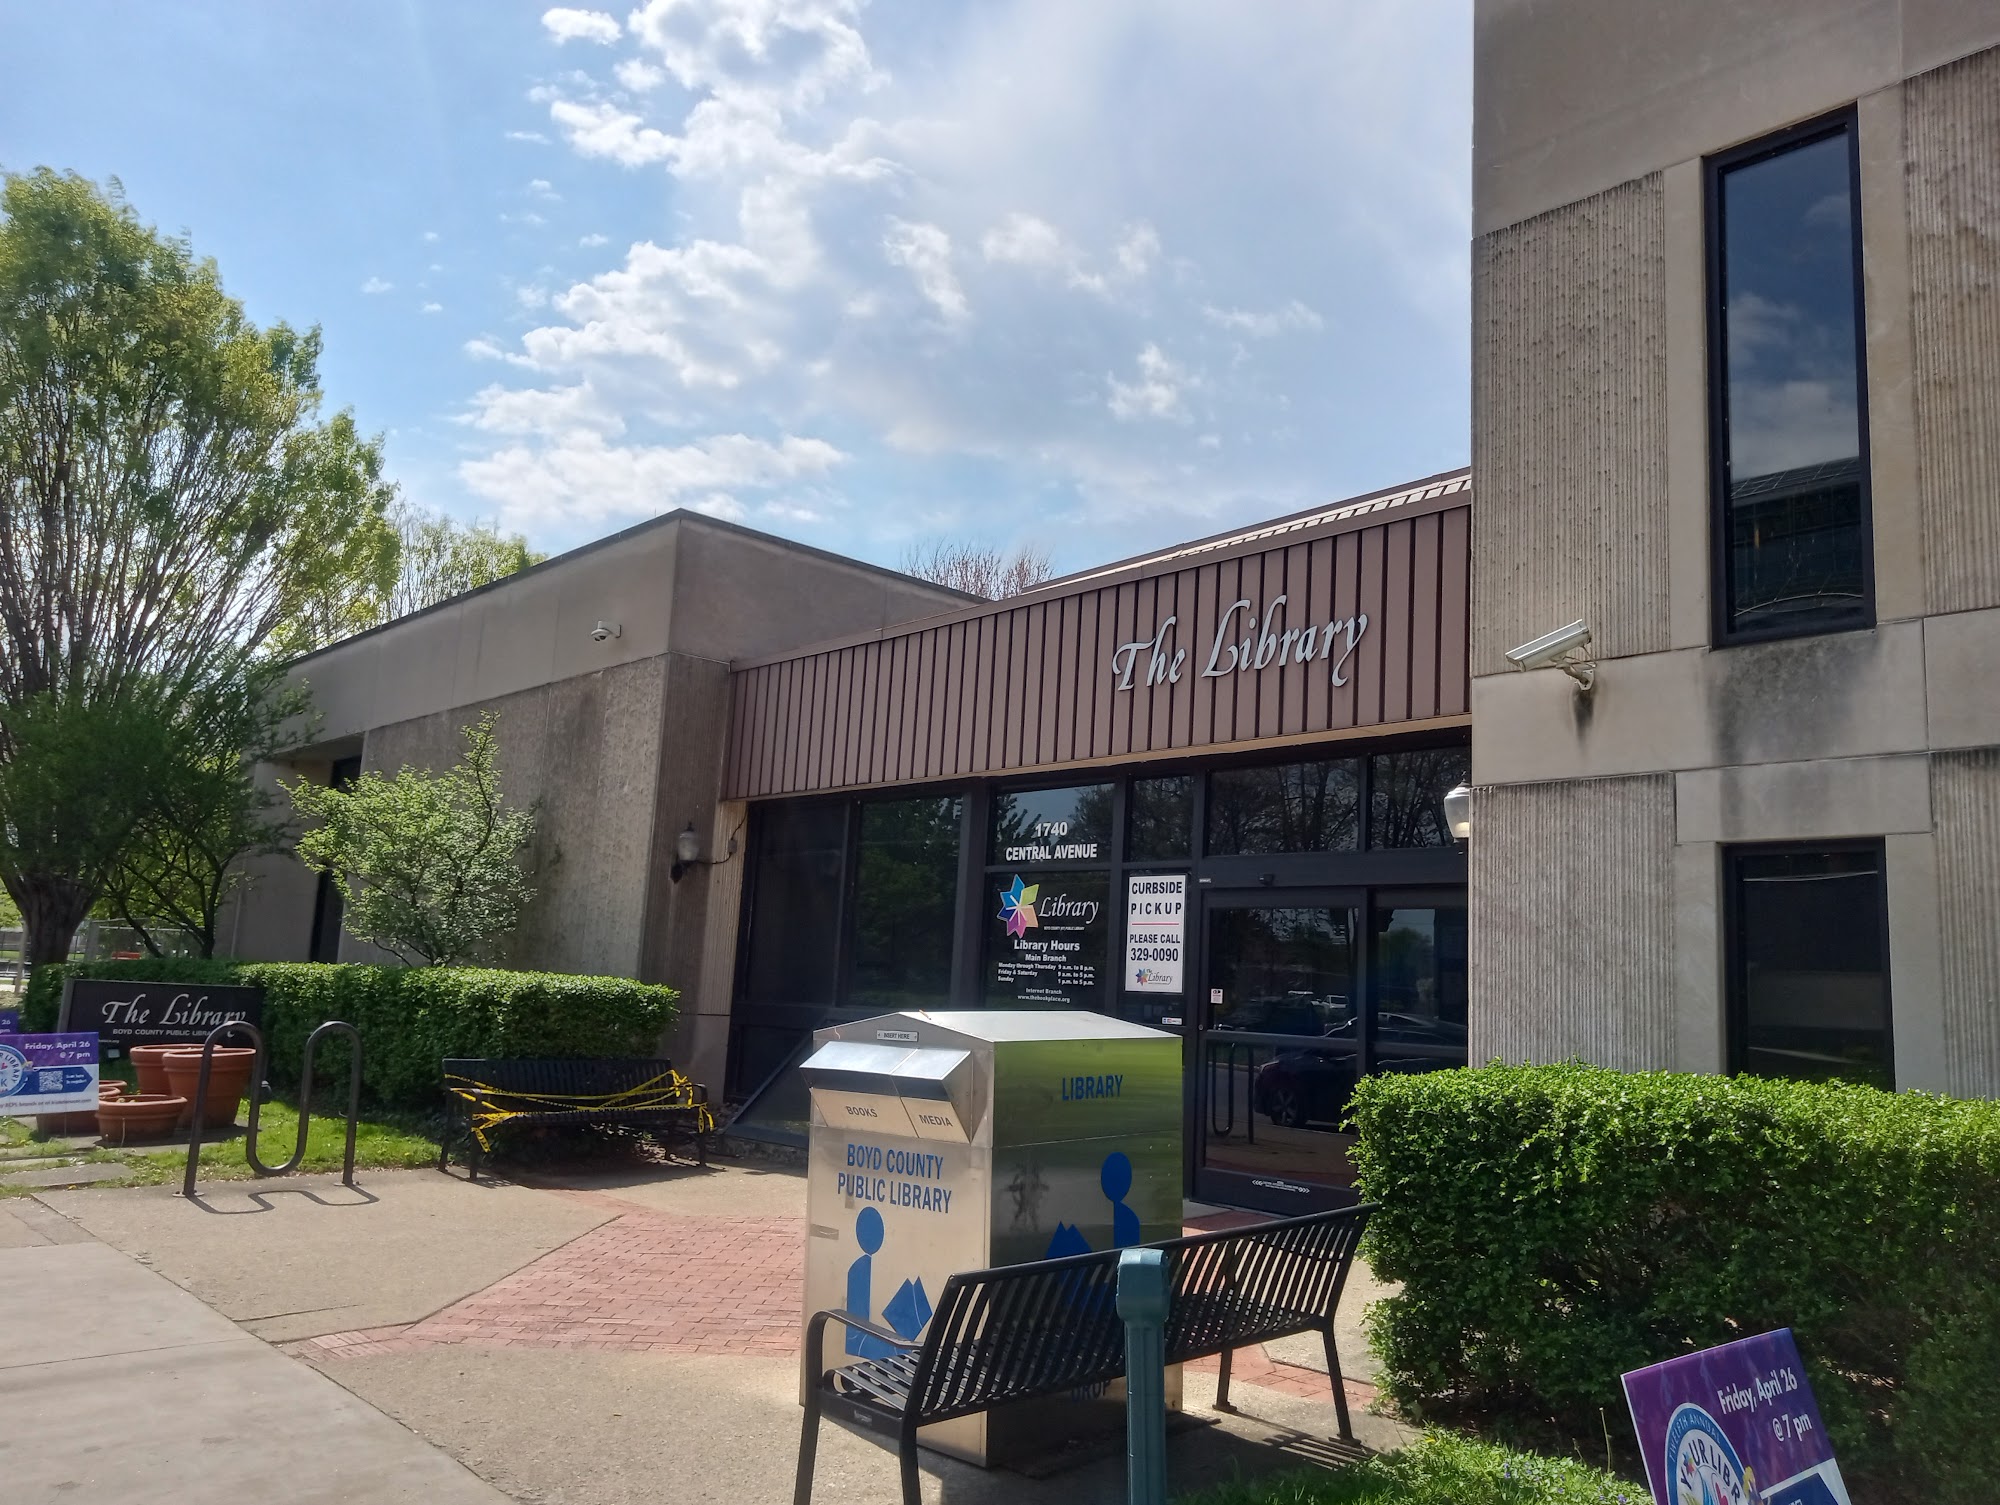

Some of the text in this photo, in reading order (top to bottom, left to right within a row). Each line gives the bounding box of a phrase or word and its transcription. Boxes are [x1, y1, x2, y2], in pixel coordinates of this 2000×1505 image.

[1112, 594, 1368, 691] The Library
[1035, 821, 1068, 837] 1740
[1005, 843, 1098, 861] CENTRAL AVENUE
[1131, 881, 1182, 895] CURBSIDE
[1038, 893, 1099, 924] Library
[1130, 902, 1182, 915] PICKUP
[1014, 940, 1080, 952] Library Hours
[1129, 934, 1180, 944] PLEASE CALL
[1025, 953, 1067, 962] Main Branch
[1130, 947, 1178, 962] 329-0090
[1017, 969, 1038, 977] Saturday
[1148, 972, 1173, 985] Library
[102, 993, 150, 1024] The
[135, 1028, 164, 1036] COUNTY
[25, 1042, 54, 1051] Friday,
[56, 1041, 77, 1050] April
[77, 1051, 91, 1059] pm
[1062, 1074, 1124, 1101] LIBRARY
[845, 1105, 878, 1118] BOOKS
[918, 1114, 954, 1127] MEDIA
[846, 1143, 944, 1180] BOYD COUNTY
[837, 1172, 952, 1214] PUBLIC LIBRARY
[1717, 1366, 1798, 1414] Friday, April 26
[1772, 1412, 1812, 1442] @ 7 pm
[1669, 1413, 1722, 1462] TWELFTH ANNUAL
